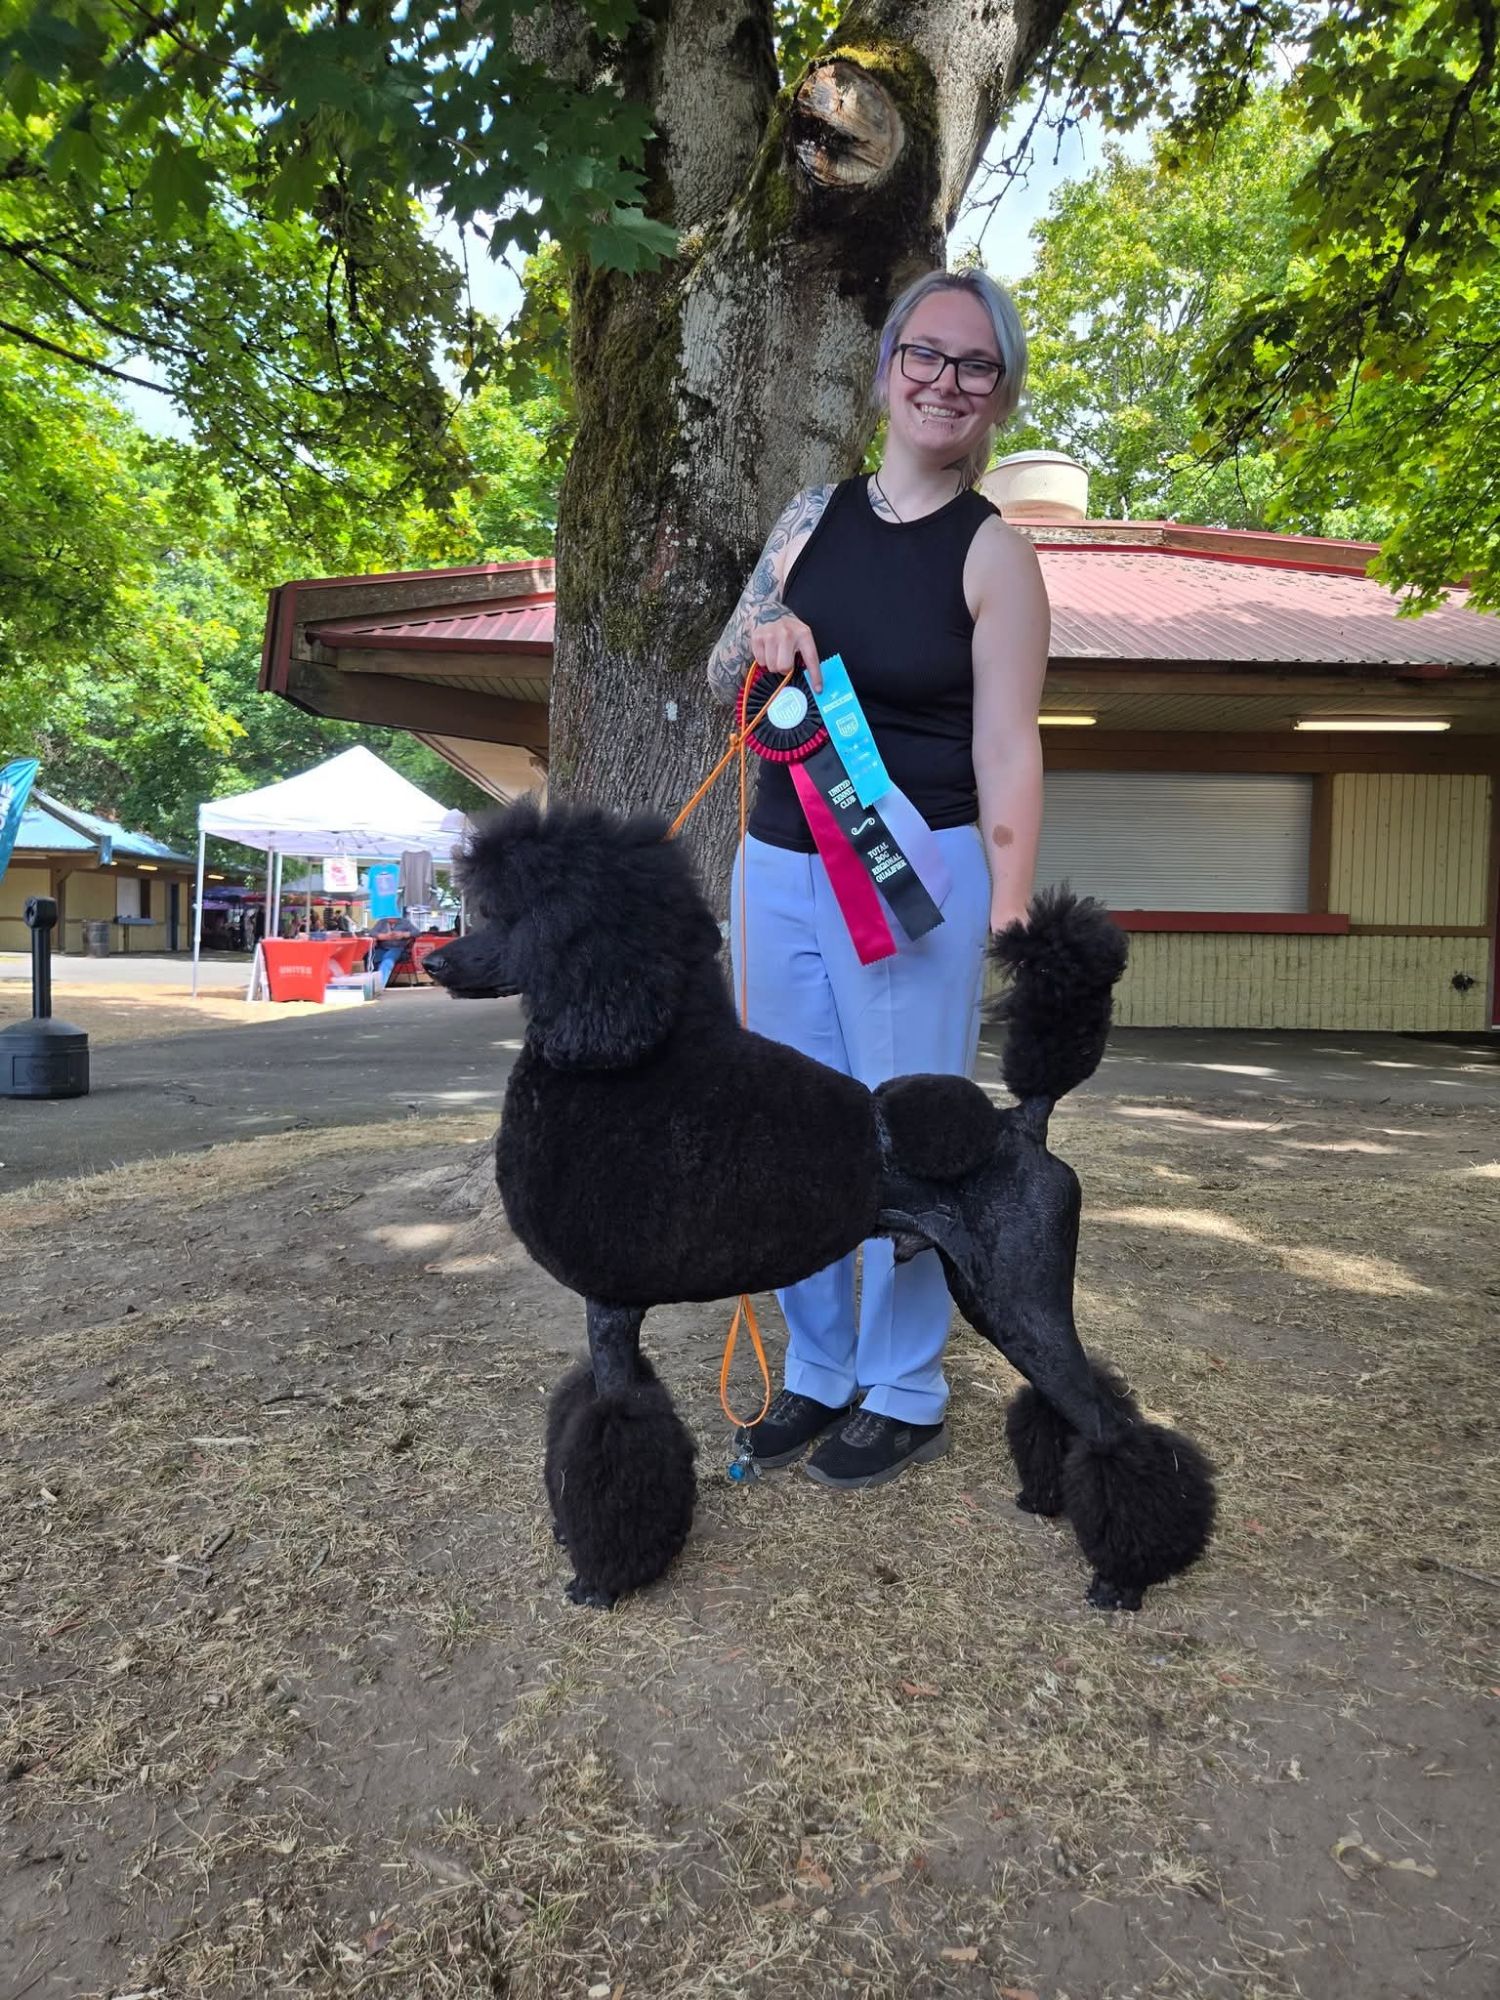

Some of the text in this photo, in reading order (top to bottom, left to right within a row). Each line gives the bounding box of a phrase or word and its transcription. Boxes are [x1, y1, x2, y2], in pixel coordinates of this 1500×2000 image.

[828, 779, 850, 796] UNITED
[840, 794, 857, 809] CLUB
[867, 842, 889, 859] TOTAL
[875, 851, 890, 864] DOG
[871, 853, 902, 876] REGIONAL
[875, 859, 907, 883] QUALIFIER
